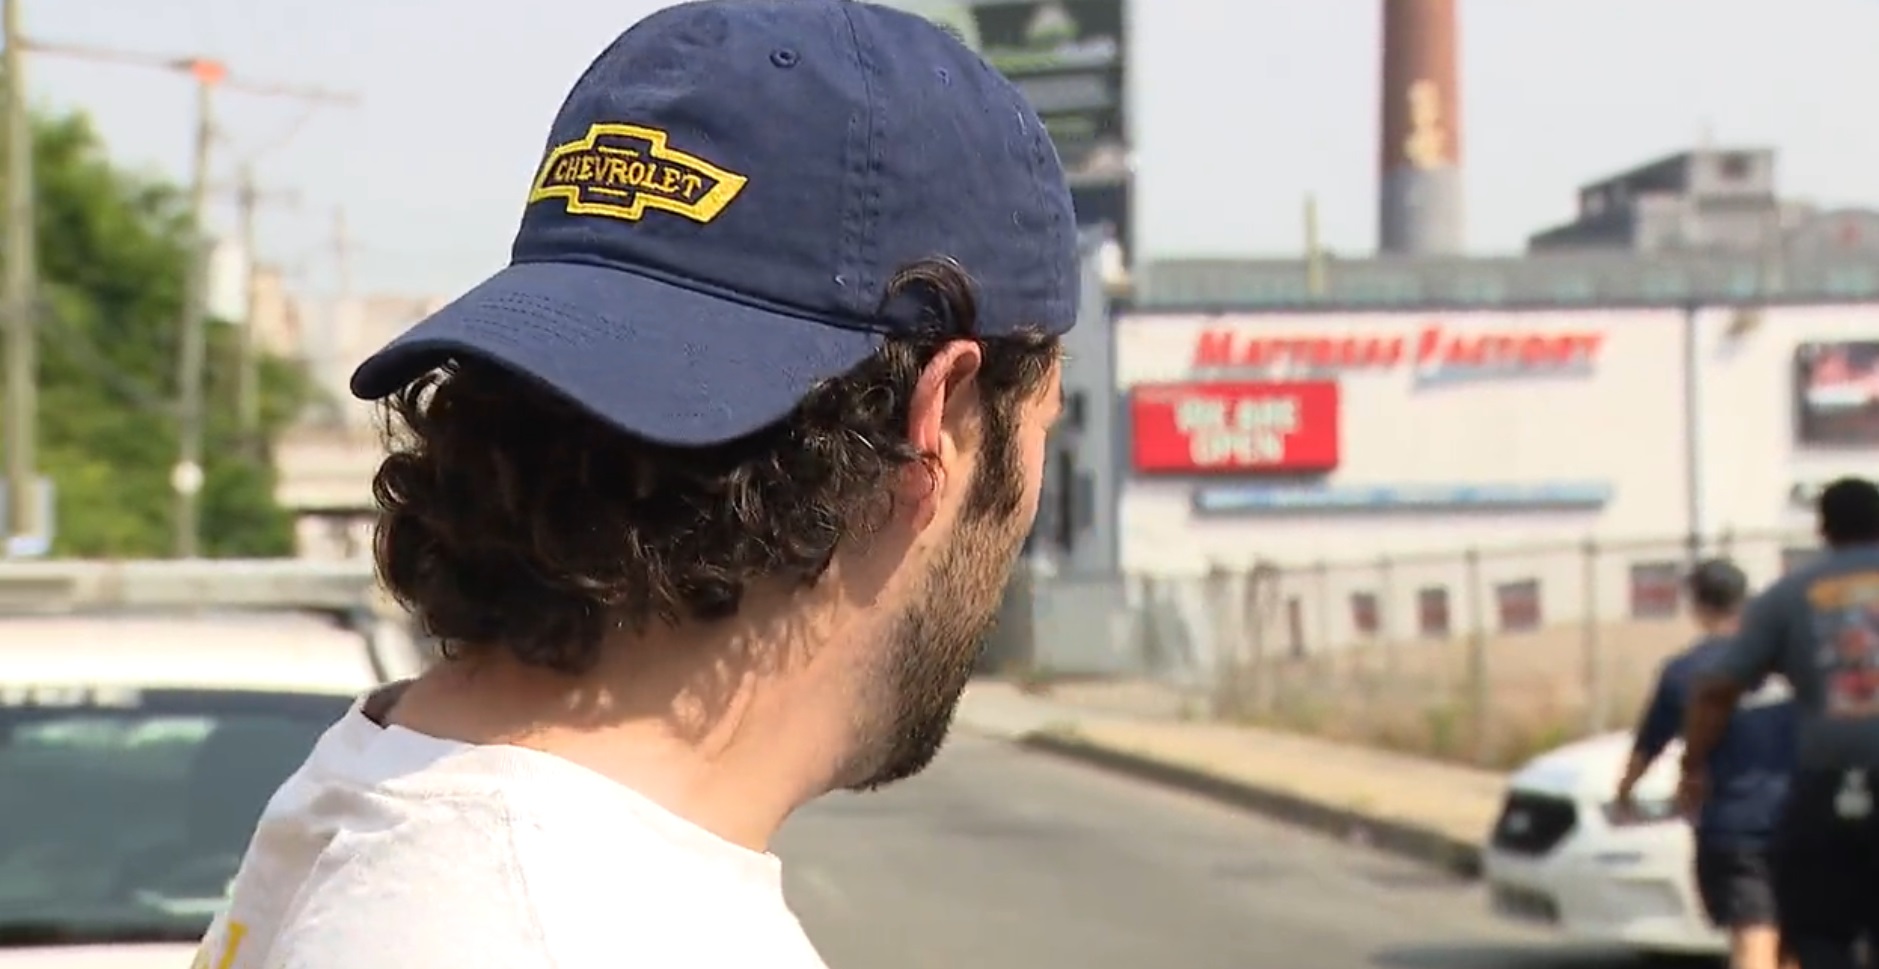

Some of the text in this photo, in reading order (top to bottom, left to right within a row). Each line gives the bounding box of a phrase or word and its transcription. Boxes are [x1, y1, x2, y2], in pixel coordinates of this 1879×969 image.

[555, 156, 701, 198] CHEVROLET
[1416, 327, 1603, 366] FACTORY
[1175, 397, 1298, 432] WE ARE
[1189, 432, 1286, 467] OPEN
